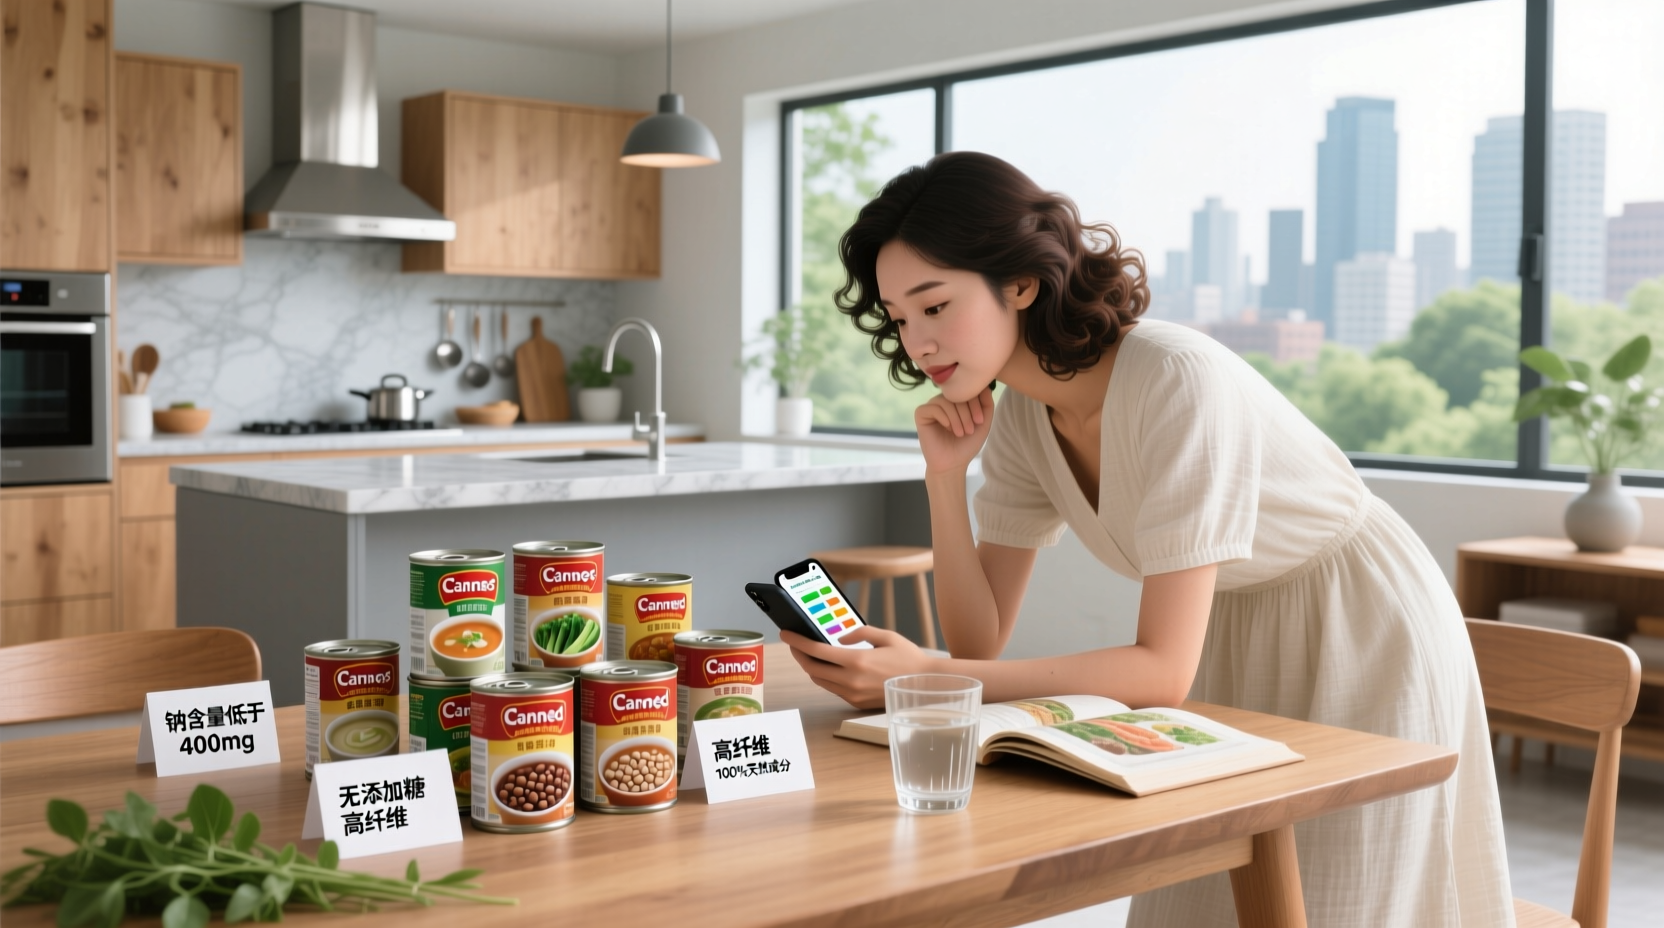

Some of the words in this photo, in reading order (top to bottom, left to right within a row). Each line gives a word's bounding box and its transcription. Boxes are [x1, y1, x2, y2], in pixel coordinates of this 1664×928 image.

[165, 702, 265, 732] 钠含量低于
[180, 734, 255, 755] 400mg
[712, 735, 771, 762] 高纤维
[339, 776, 425, 807] 无添加糖
[341, 806, 408, 836] 高纤维
